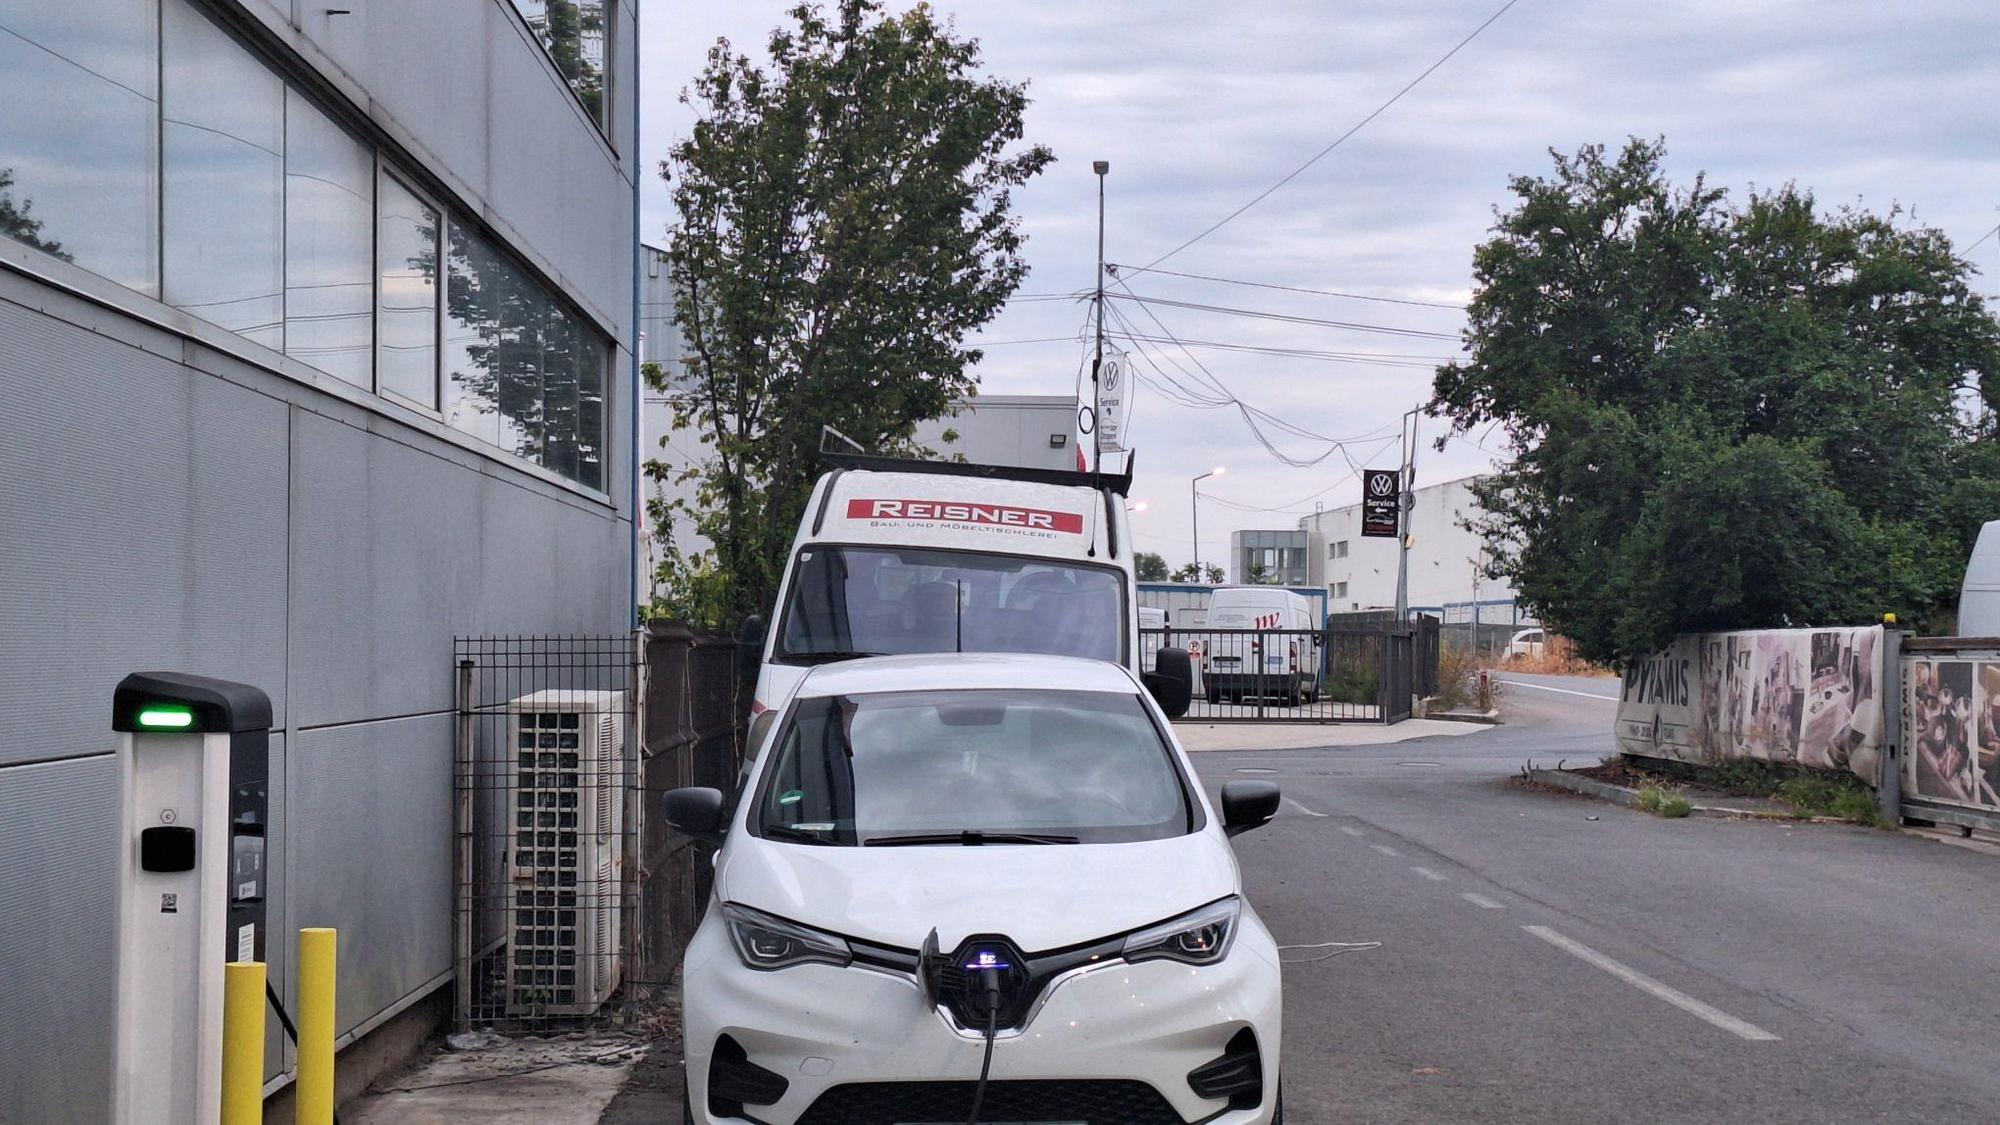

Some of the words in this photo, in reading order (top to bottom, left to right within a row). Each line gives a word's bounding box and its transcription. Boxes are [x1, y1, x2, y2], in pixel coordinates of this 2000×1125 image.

[1367, 499, 1395, 507] Service
[872, 500, 1054, 529] REISNER
[1622, 659, 1689, 707] PYRAMIS
[236, 858, 241, 874] A
[254, 853, 260, 870] B
